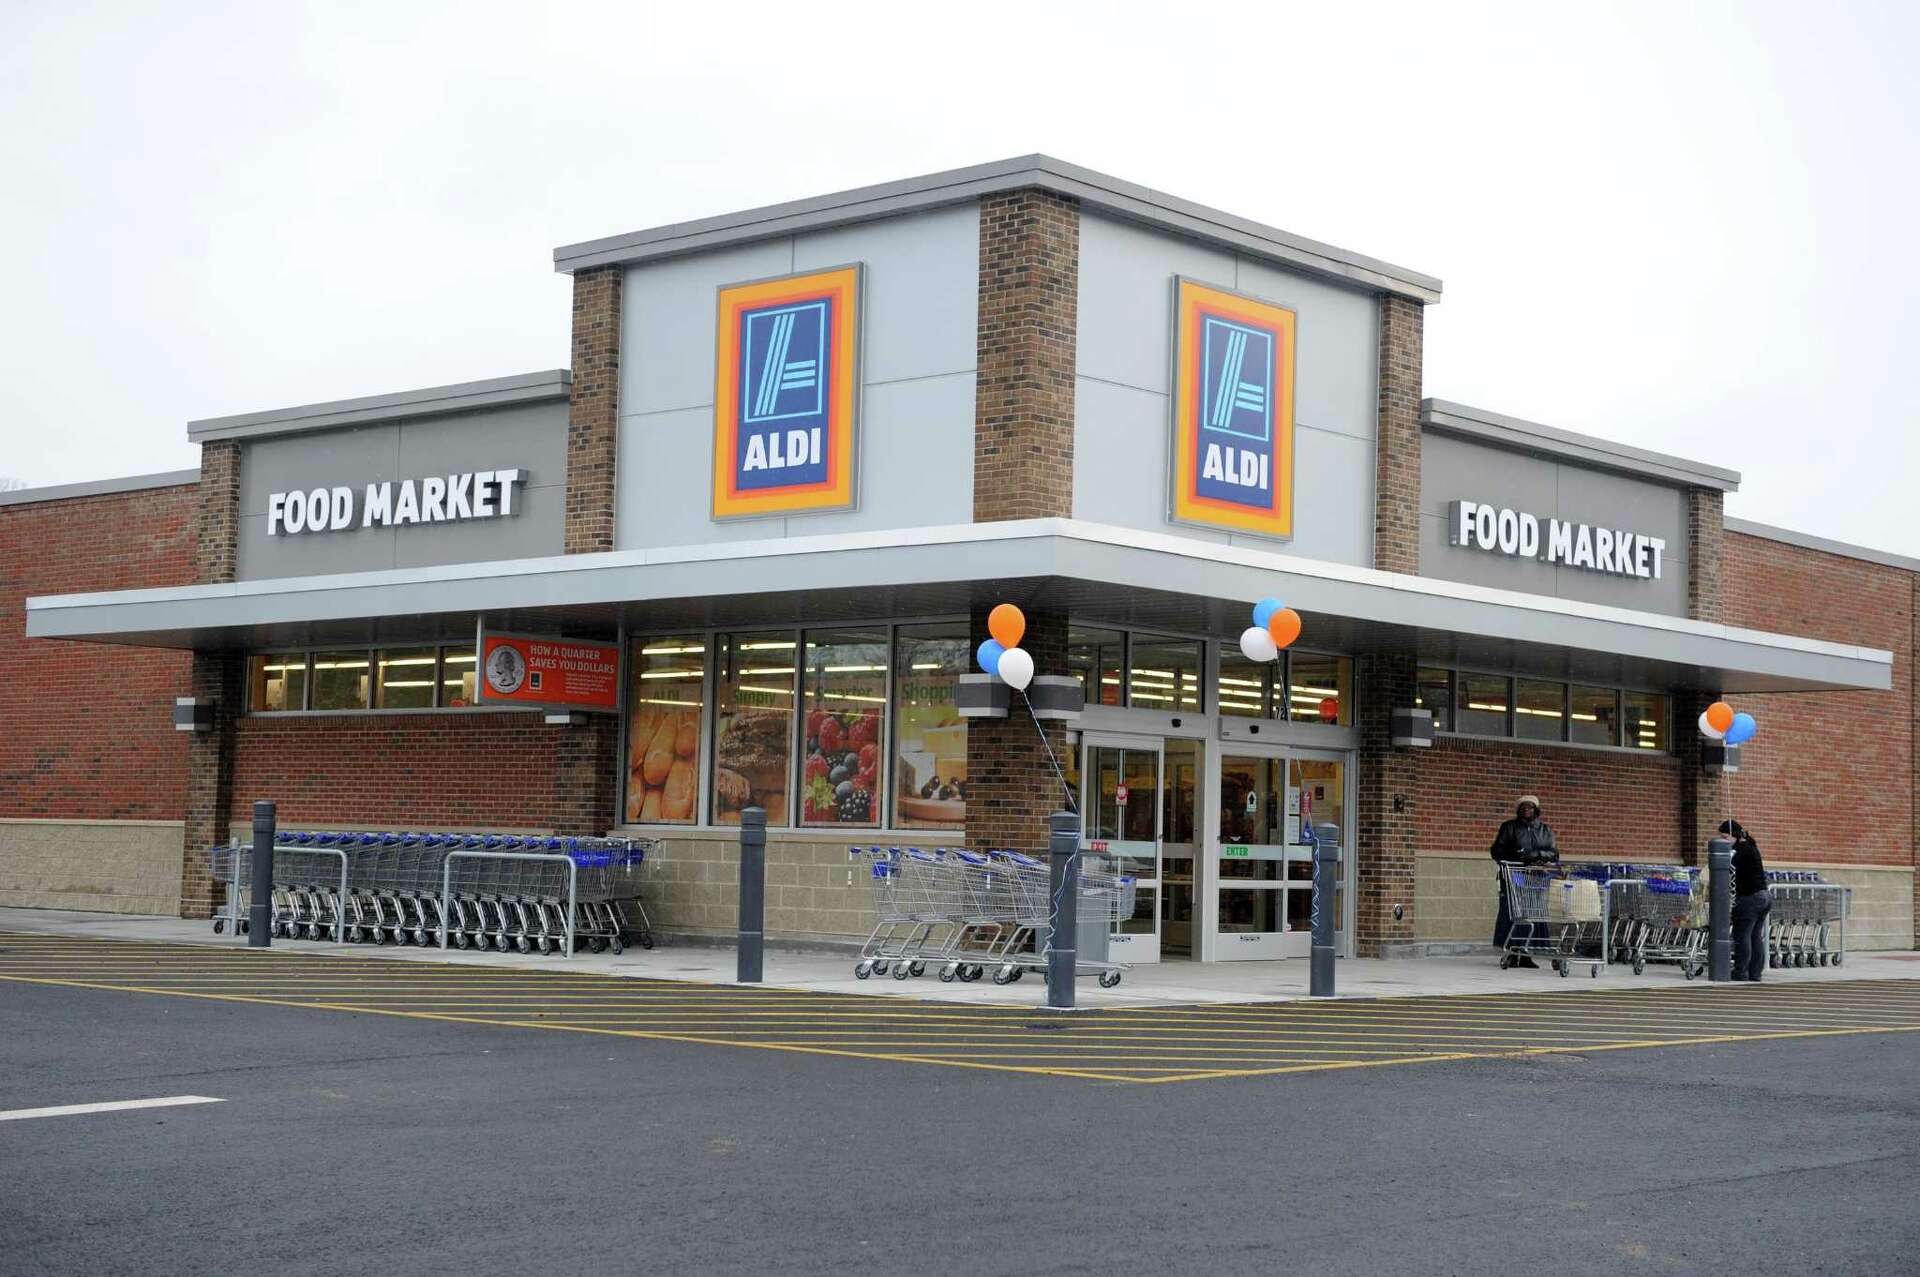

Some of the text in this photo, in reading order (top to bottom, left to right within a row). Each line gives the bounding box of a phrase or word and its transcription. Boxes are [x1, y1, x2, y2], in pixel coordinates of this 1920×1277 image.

[743, 427, 821, 472] ALDI
[1202, 442, 1268, 490] ALDI
[267, 468, 519, 536] FOOD MARKET
[1459, 500, 1666, 579] FOOD MARKET
[529, 657, 615, 674] SAVES YOU DOLLARS
[530, 645, 600, 660] HOW A QUARTER
[1091, 841, 1109, 852] EXIT
[1226, 846, 1249, 857] ENTER
